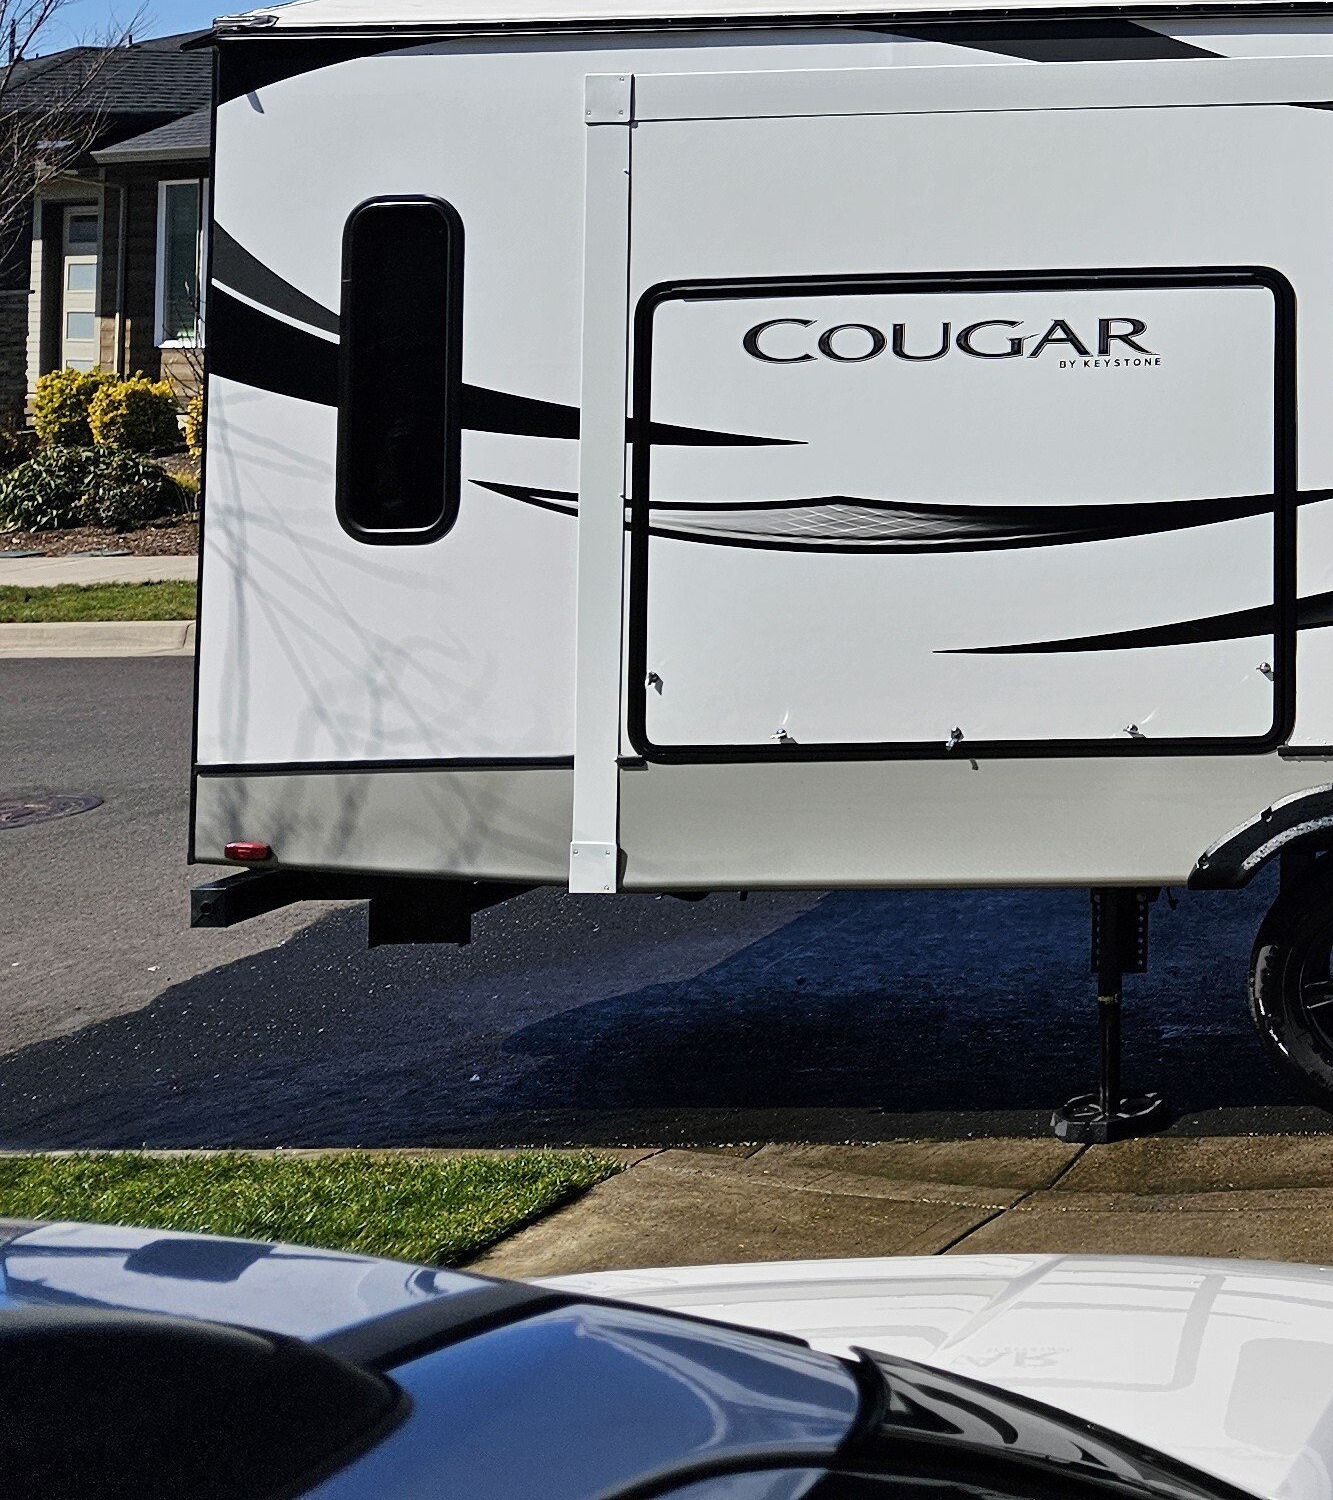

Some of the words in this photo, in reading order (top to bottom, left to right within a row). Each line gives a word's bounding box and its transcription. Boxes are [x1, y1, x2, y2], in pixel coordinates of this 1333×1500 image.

[743, 317, 1160, 364] COUGAR
[1059, 360, 1076, 369] BY
[1083, 357, 1161, 368] KEYSTONE
